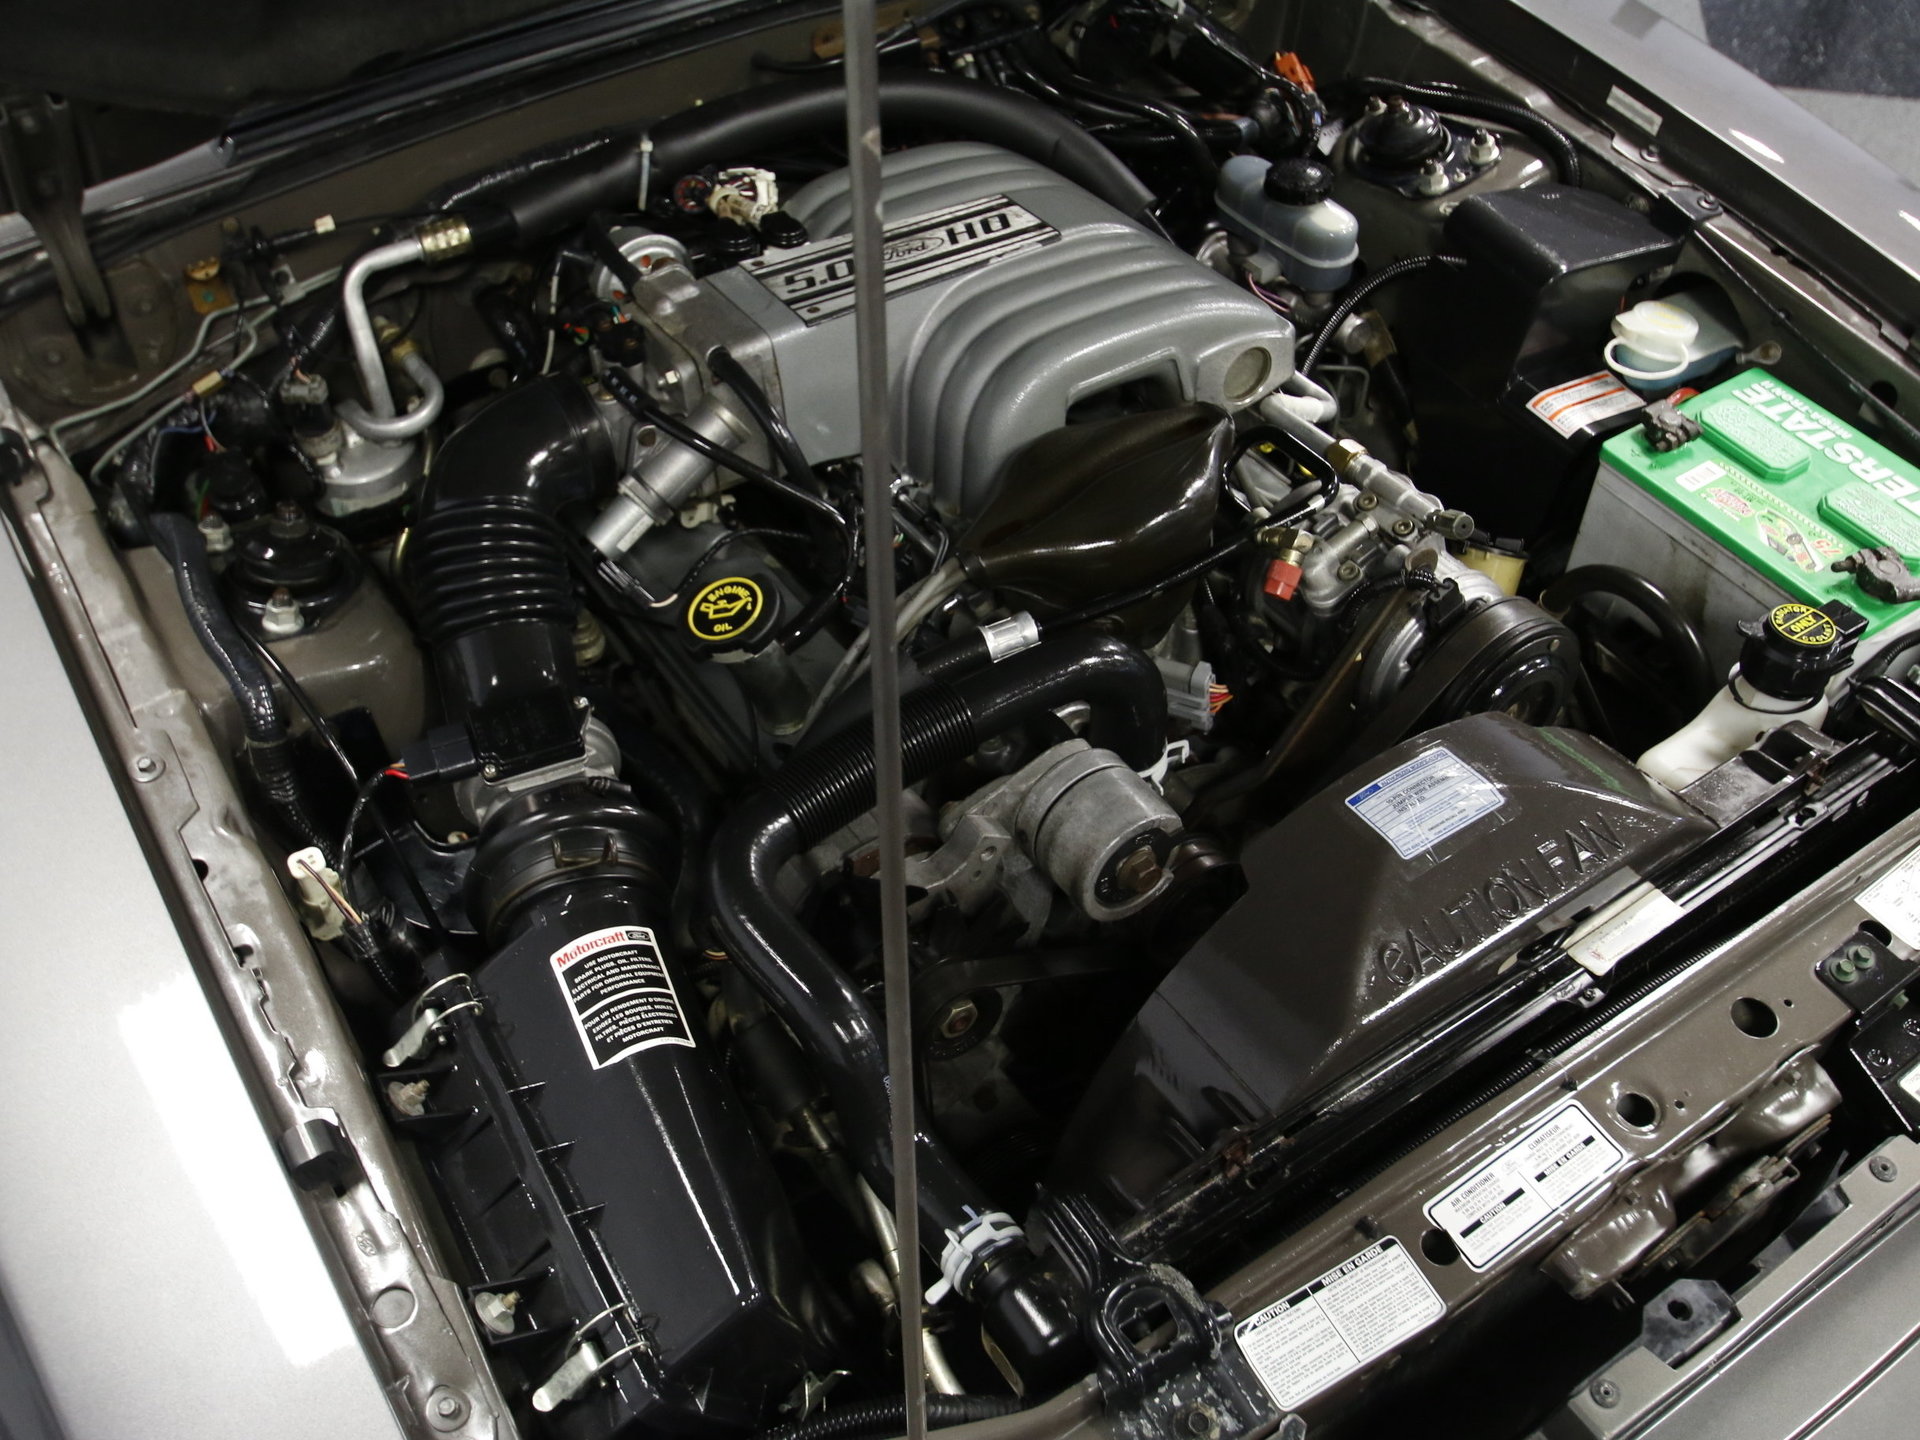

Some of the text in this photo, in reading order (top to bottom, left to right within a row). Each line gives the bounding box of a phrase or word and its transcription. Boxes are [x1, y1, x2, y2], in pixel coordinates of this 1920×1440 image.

[946, 213, 1011, 245] HO
[707, 585, 751, 602] ENGINE
[1772, 603, 1809, 626] RADIATOR
[1789, 614, 1817, 633] ONLY
[713, 623, 732, 632] OIL
[1381, 768, 1410, 786] AUTHORIZED
[1403, 775, 1435, 795] CONNECTOR
[1393, 793, 1413, 808] JUMPER
[1414, 786, 1428, 796] WIRE
[1384, 858, 1549, 985] CAUTION
[1537, 812, 1623, 888] FAN
[556, 932, 626, 967] Motorcraft
[584, 950, 638, 968] USE MOTORCRAFT
[572, 973, 605, 994] ELECTRICAL
[606, 968, 620, 976] AND
[574, 969, 594, 983] SPARK
[600, 979, 645, 995] PERFORMANCE
[573, 989, 591, 1003] PARTS
[592, 981, 604, 992] FOR
[604, 973, 634, 984] ORIGINAL
[584, 1016, 600, 1030] POUR
[600, 1010, 610, 1019] UN
[610, 998, 647, 1014] RENDEMENT
[592, 1019, 612, 1034] EXIGEZ
[613, 1013, 624, 1021] LES
[619, 1015, 641, 1026] PIÈCES
[606, 1019, 673, 1043] ET PIÈCES D'ENTRETIEN
[622, 1026, 664, 1043] MOTORCRAFT
[1527, 1124, 1560, 1150] CLIMATISEUR
[1542, 1141, 1586, 1176] MISE EN GARDE
[1450, 1196, 1461, 1207] AIR
[1459, 1171, 1495, 1199] CONDITIONER
[1478, 1201, 1506, 1223] CAUTION
[1321, 1270, 1343, 1287] MISE
[1342, 1262, 1356, 1273] EN
[1354, 1245, 1383, 1266] GARDE
[1254, 1301, 1290, 1327] CAUTION
